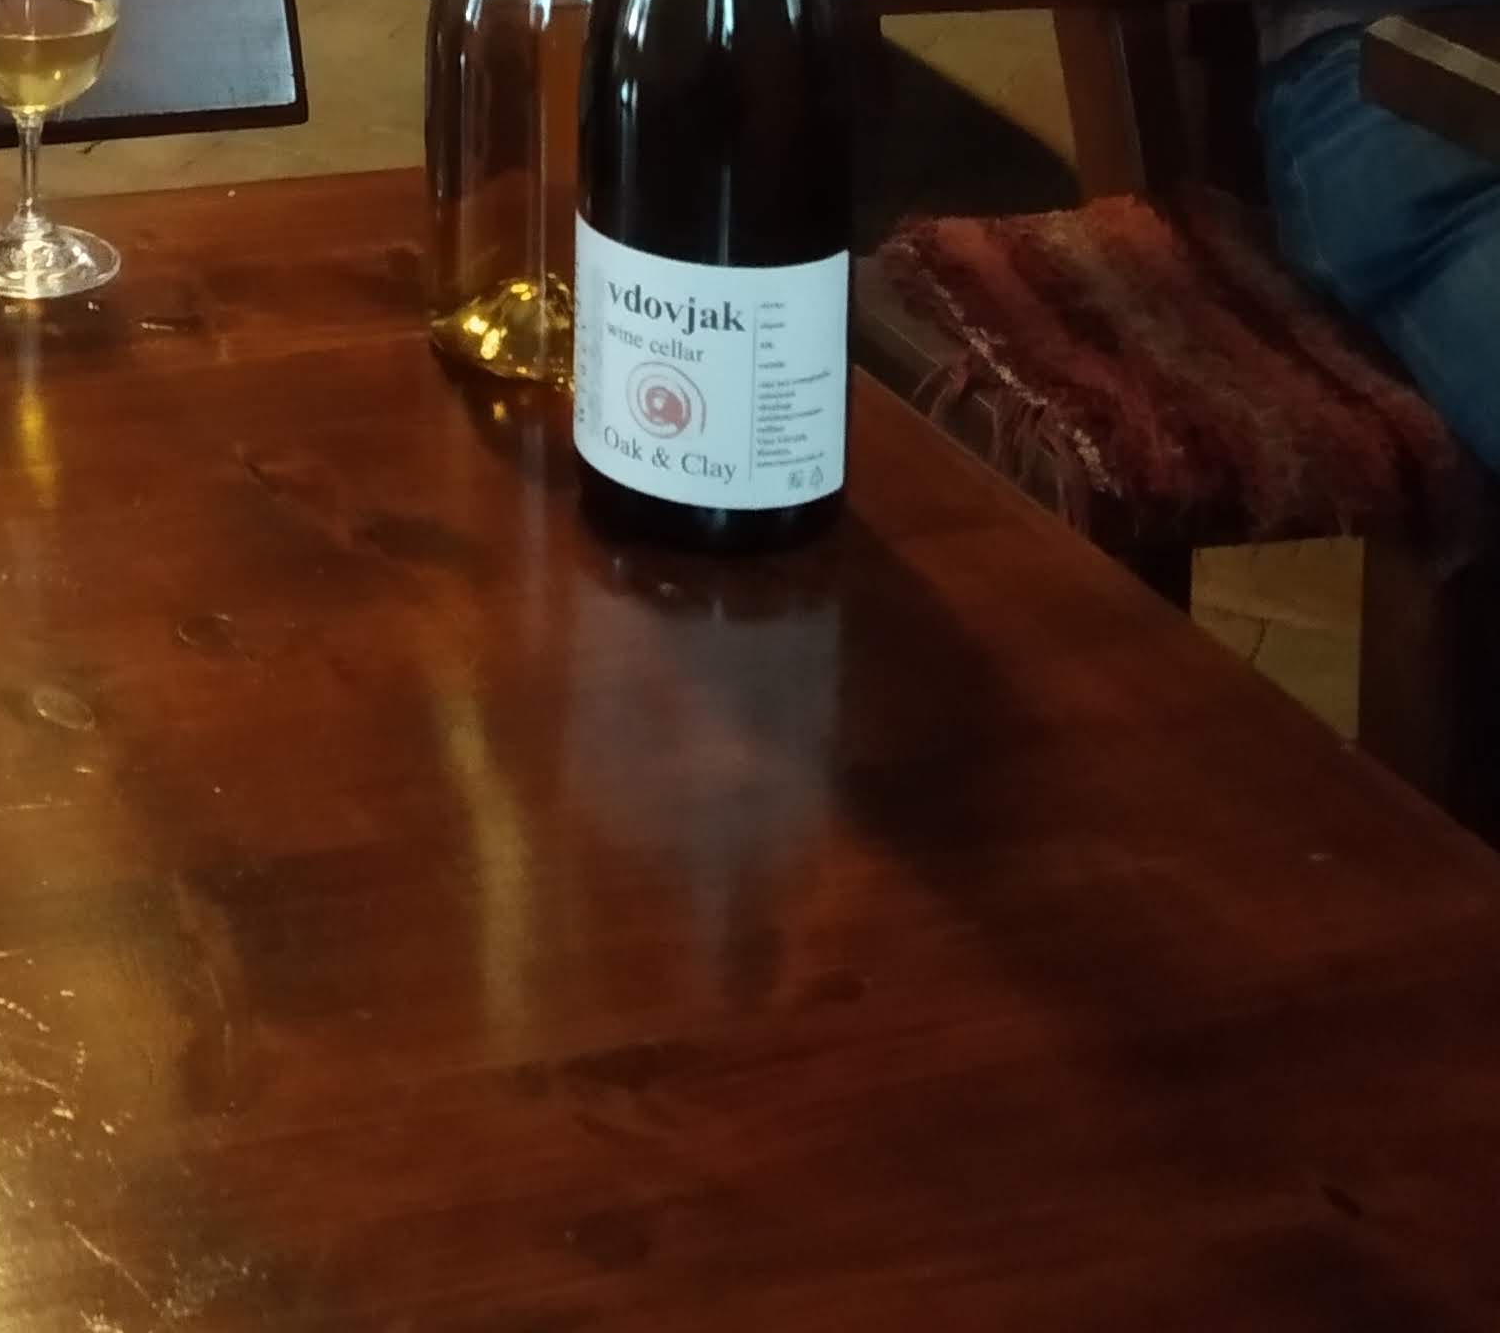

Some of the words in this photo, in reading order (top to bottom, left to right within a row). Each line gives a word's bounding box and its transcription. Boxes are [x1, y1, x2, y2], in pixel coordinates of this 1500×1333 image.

[606, 280, 747, 336] vdovjak
[604, 322, 644, 350] wine
[648, 337, 706, 363] cellar
[603, 424, 644, 462] Oak
[651, 445, 672, 471] &
[680, 452, 738, 486] Clay
